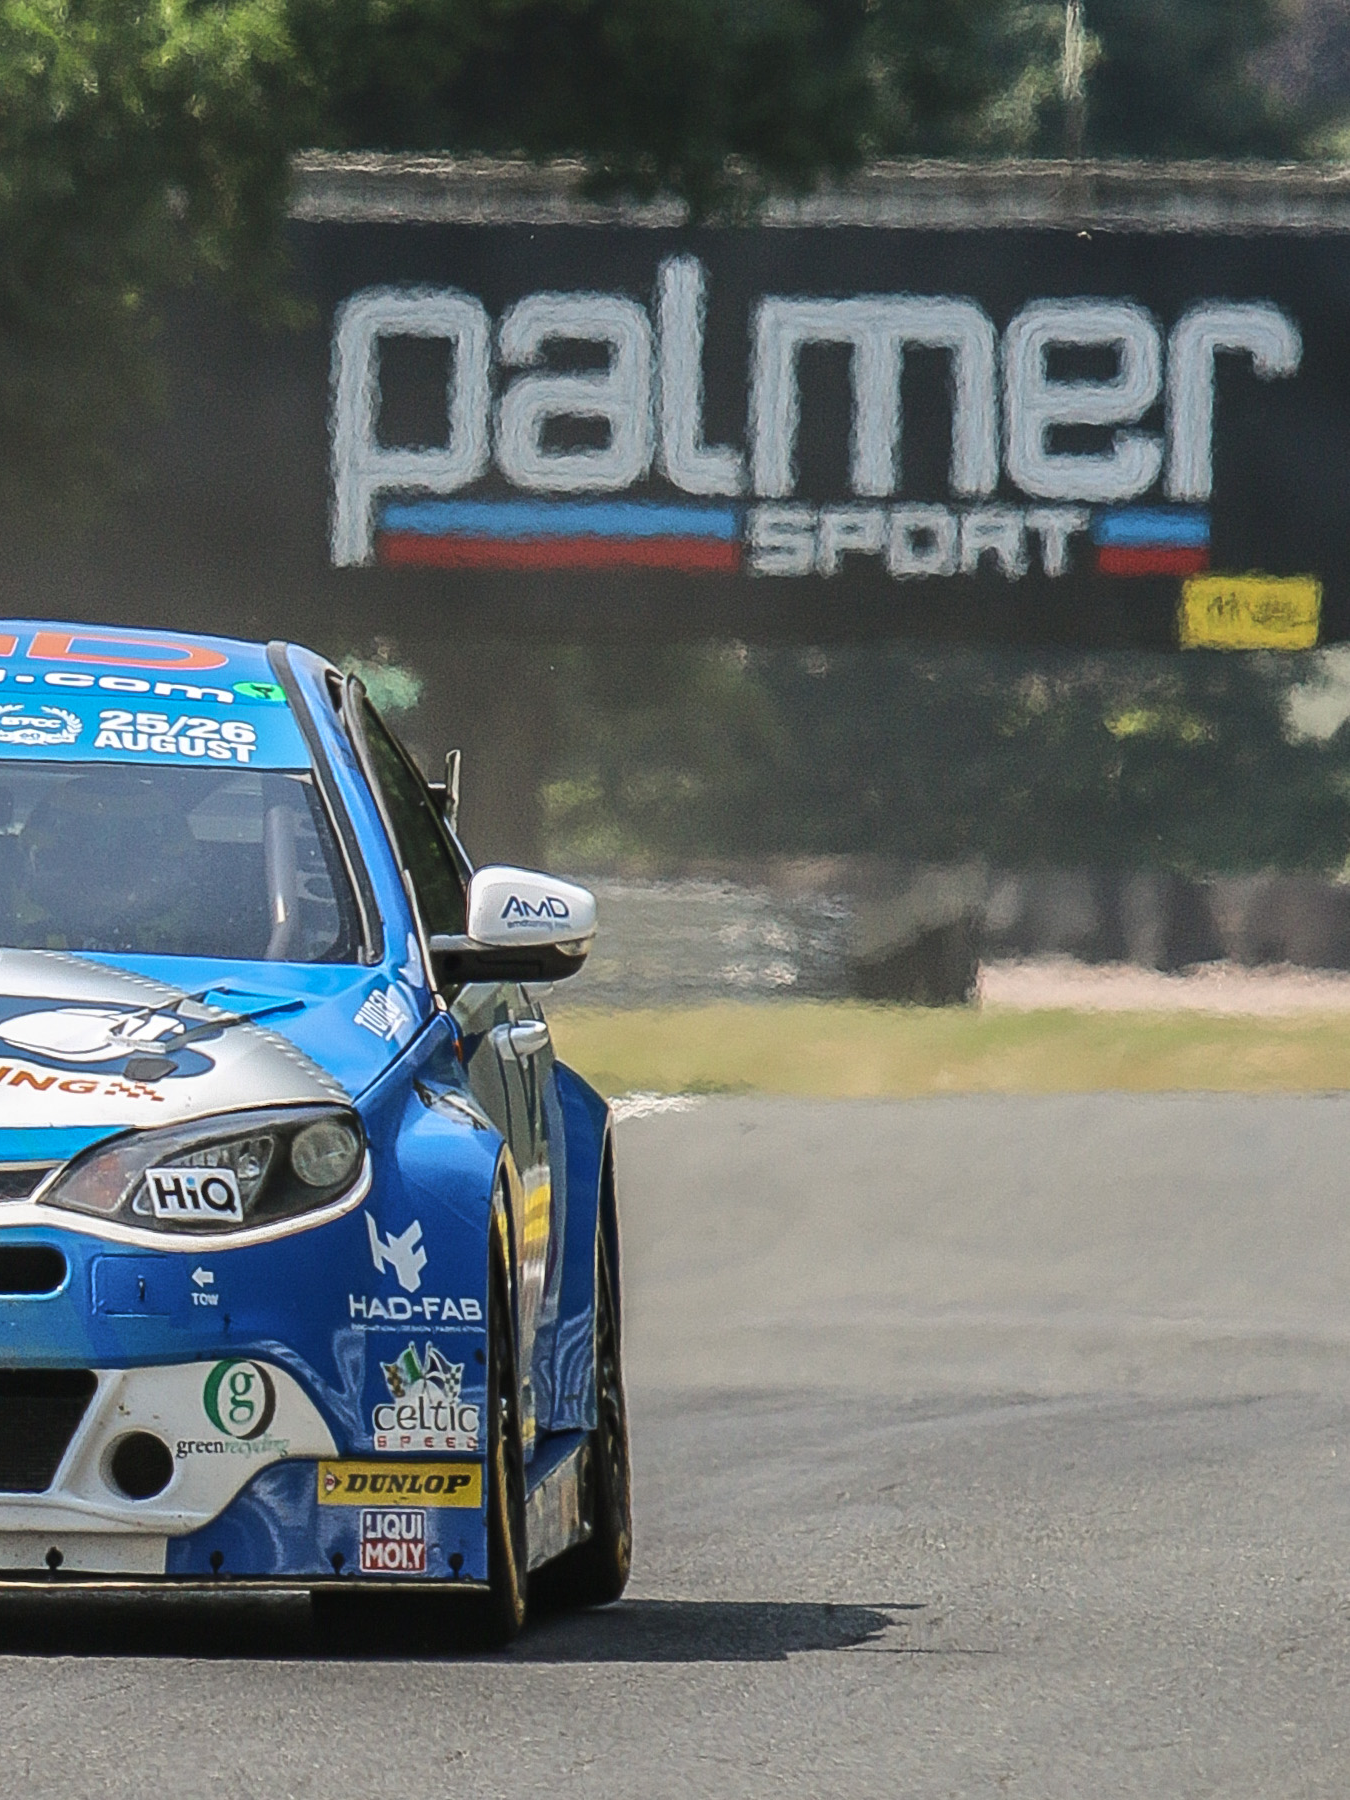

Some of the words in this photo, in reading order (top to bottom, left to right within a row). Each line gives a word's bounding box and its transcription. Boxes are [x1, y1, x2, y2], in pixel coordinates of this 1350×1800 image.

[330, 252, 1303, 568] palmer
[745, 503, 1093, 578] SPORT
[98, 709, 257, 743] 25/26
[94, 730, 257, 763] AUGUST
[501, 895, 570, 919] AMD
[152, 1175, 237, 1214] HiQ
[191, 1292, 219, 1306] TOW
[348, 1294, 483, 1320] HAD-FAB
[229, 1371, 256, 1424] g
[374, 1396, 478, 1433] celtic
[377, 1435, 478, 1450] SPEED
[345, 1473, 472, 1494] DUNLOP
[366, 1514, 423, 1540] LIQUI
[365, 1542, 425, 1569] MOLY
